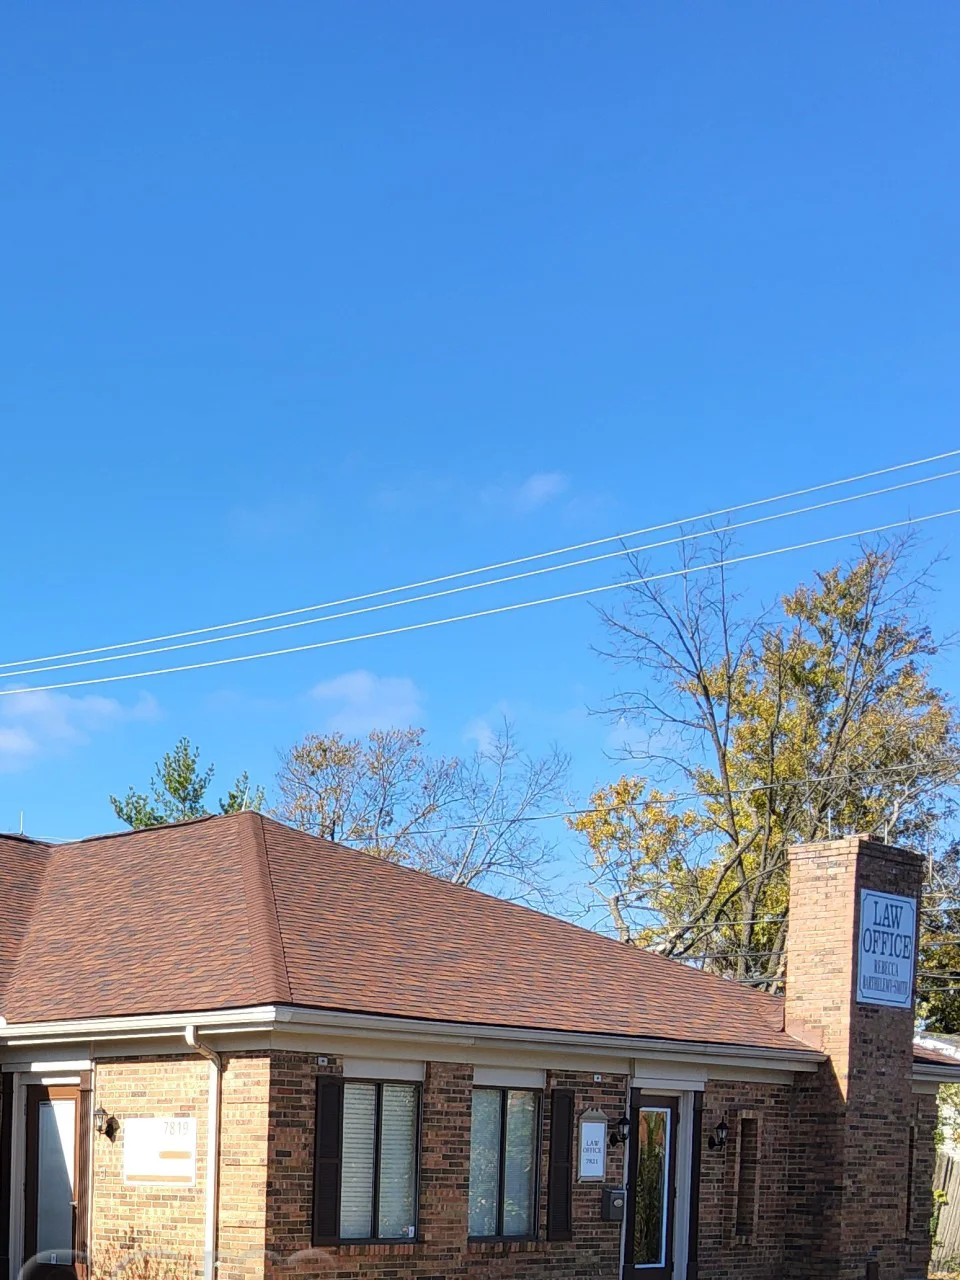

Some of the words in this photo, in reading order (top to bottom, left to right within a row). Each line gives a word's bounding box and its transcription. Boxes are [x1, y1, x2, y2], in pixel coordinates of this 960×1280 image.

[873, 901, 903, 929] LAW
[863, 928, 911, 959] OFFICE
[874, 959, 898, 976] REBECCA
[164, 1121, 188, 1135] 7819
[582, 1146, 602, 1154] OFFICE
